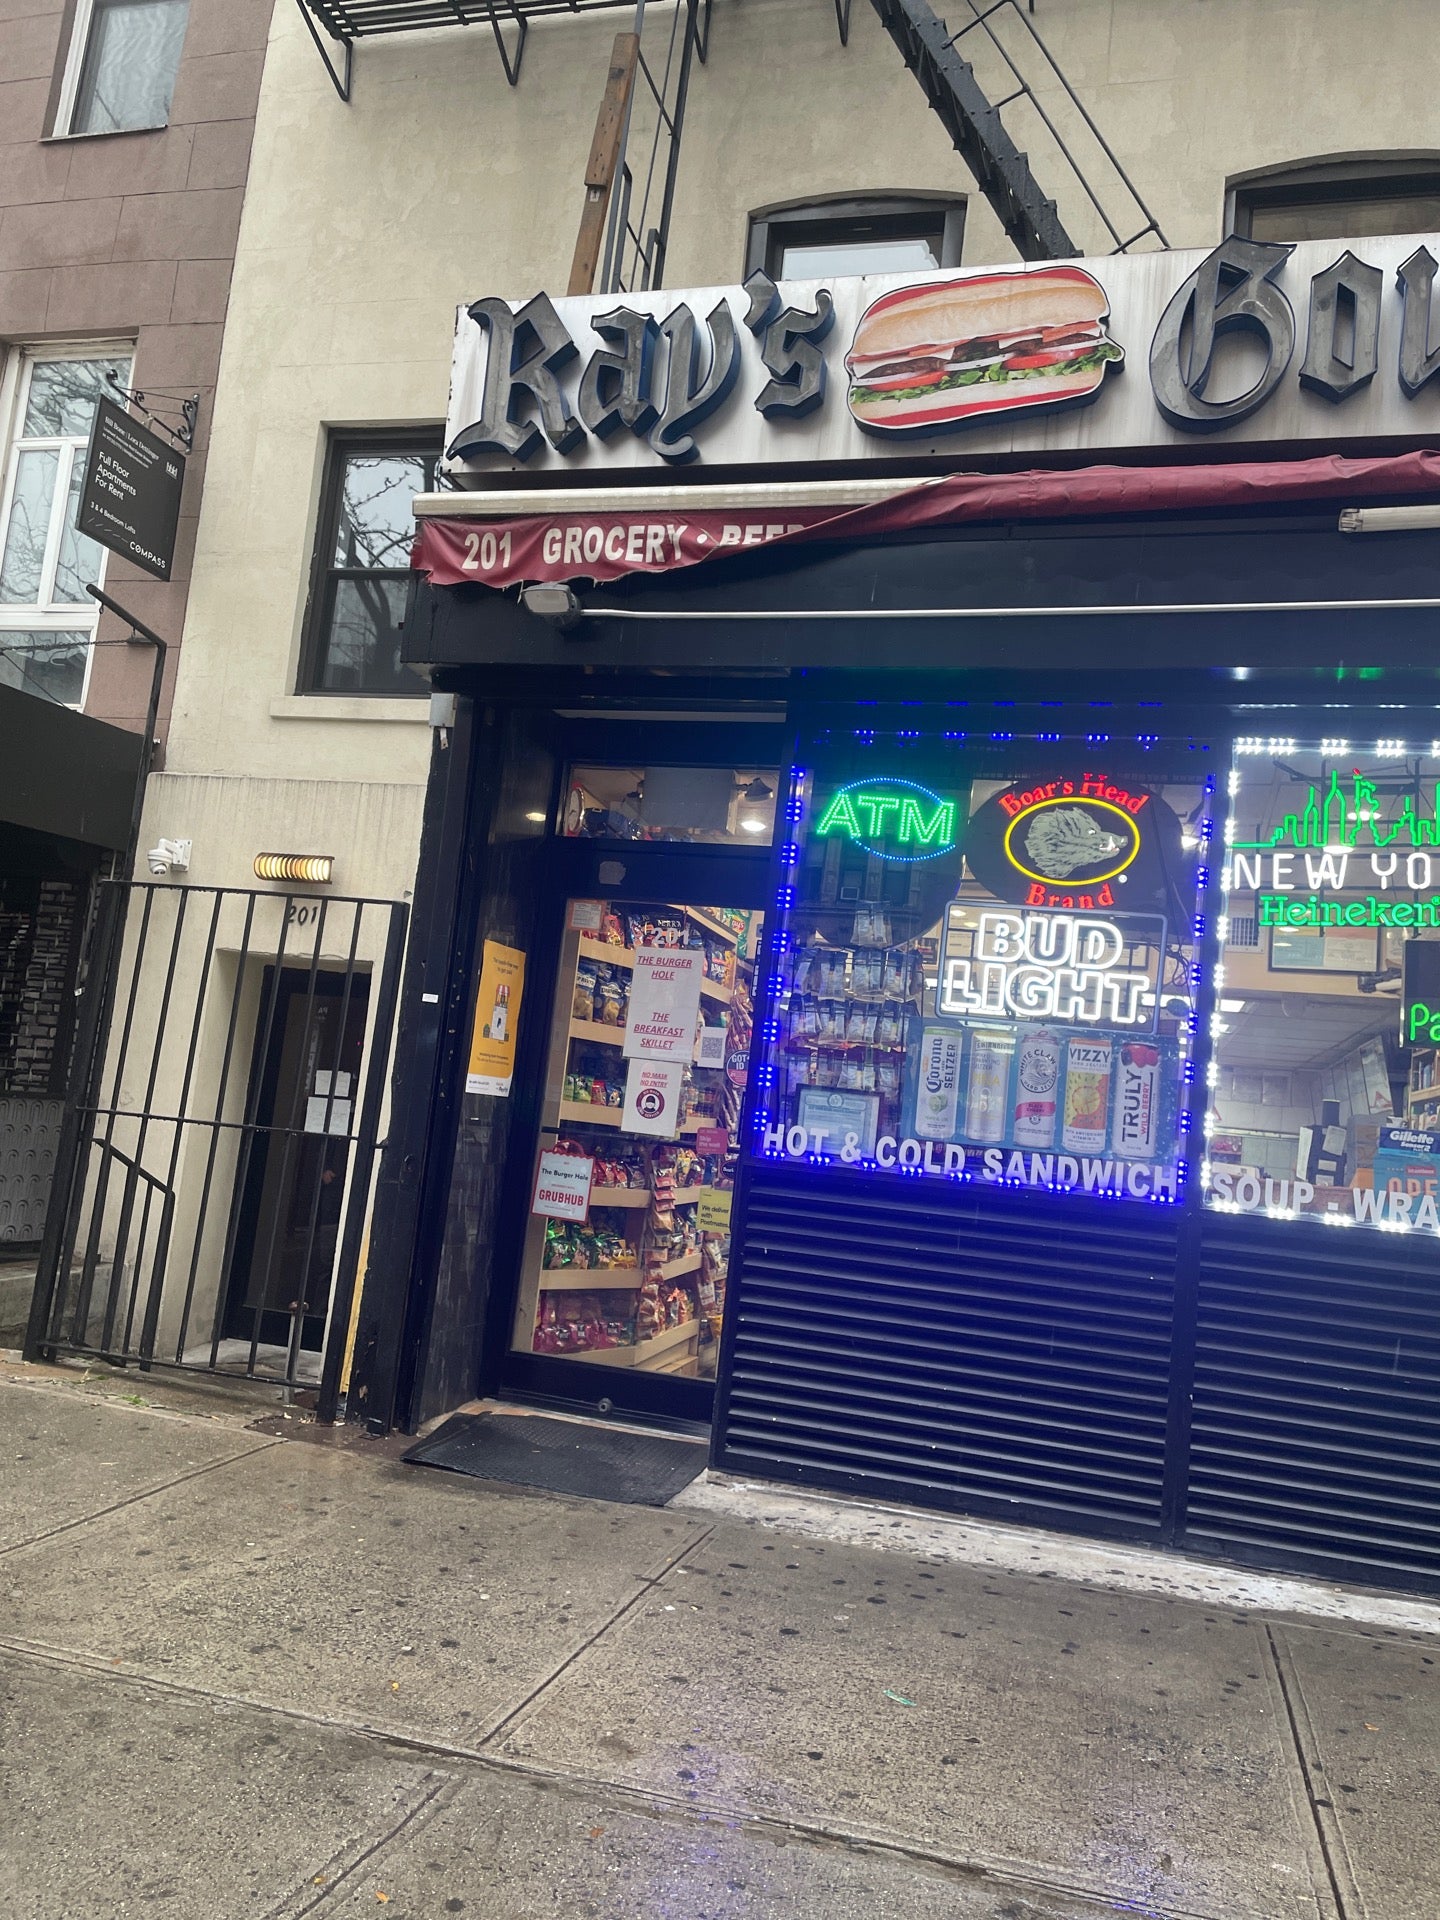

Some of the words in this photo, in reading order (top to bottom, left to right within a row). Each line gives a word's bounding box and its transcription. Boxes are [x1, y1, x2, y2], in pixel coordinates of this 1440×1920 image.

[446, 268, 836, 466] Ray's
[98, 451, 112, 467] Full
[112, 460, 130, 478] Floor
[95, 474, 107, 489] For
[108, 481, 124, 500] Rent
[97, 464, 137, 496] Apartments
[129, 541, 166, 569] COMPASS
[462, 531, 513, 570] 201
[542, 524, 688, 564] GROCERY
[719, 524, 805, 546] BEE
[998, 776, 1074, 817] Boar's
[1080, 773, 1149, 814] Head
[816, 792, 956, 846] ATM
[1234, 853, 1348, 890] NEW
[1025, 883, 1115, 909] Brand
[288, 905, 318, 926] 201
[1259, 895, 1440, 928] Heineken
[651, 922, 691, 946] 201
[978, 913, 1123, 970] BUD
[637, 955, 654, 967] THE
[655, 957, 693, 969] BURGER
[651, 970, 676, 981] HOLE
[633, 1024, 685, 1038] BREAKFAST
[651, 1012, 670, 1023] THE
[640, 1038, 674, 1050] SKILLET
[1069, 1047, 1110, 1063] VIZZY
[926, 1038, 943, 1093] Corona
[944, 1044, 956, 1089] SELTZER
[1019, 1050, 1033, 1077] WHITE
[1034, 1049, 1057, 1065] CLAW
[1122, 1069, 1141, 1142] TRULY
[1141, 1082, 1150, 1109] BERRY
[1390, 1130, 1434, 1145] Gillette
[542, 1168, 552, 1176] The
[554, 1170, 573, 1179] Burger
[763, 1122, 829, 1157] HOT
[840, 1131, 862, 1163] &
[876, 1135, 966, 1175] COLD
[982, 1148, 1178, 1201] SANDWICH
[539, 1189, 584, 1206] GRUBHUB
[1211, 1172, 1314, 1212] SOUP
